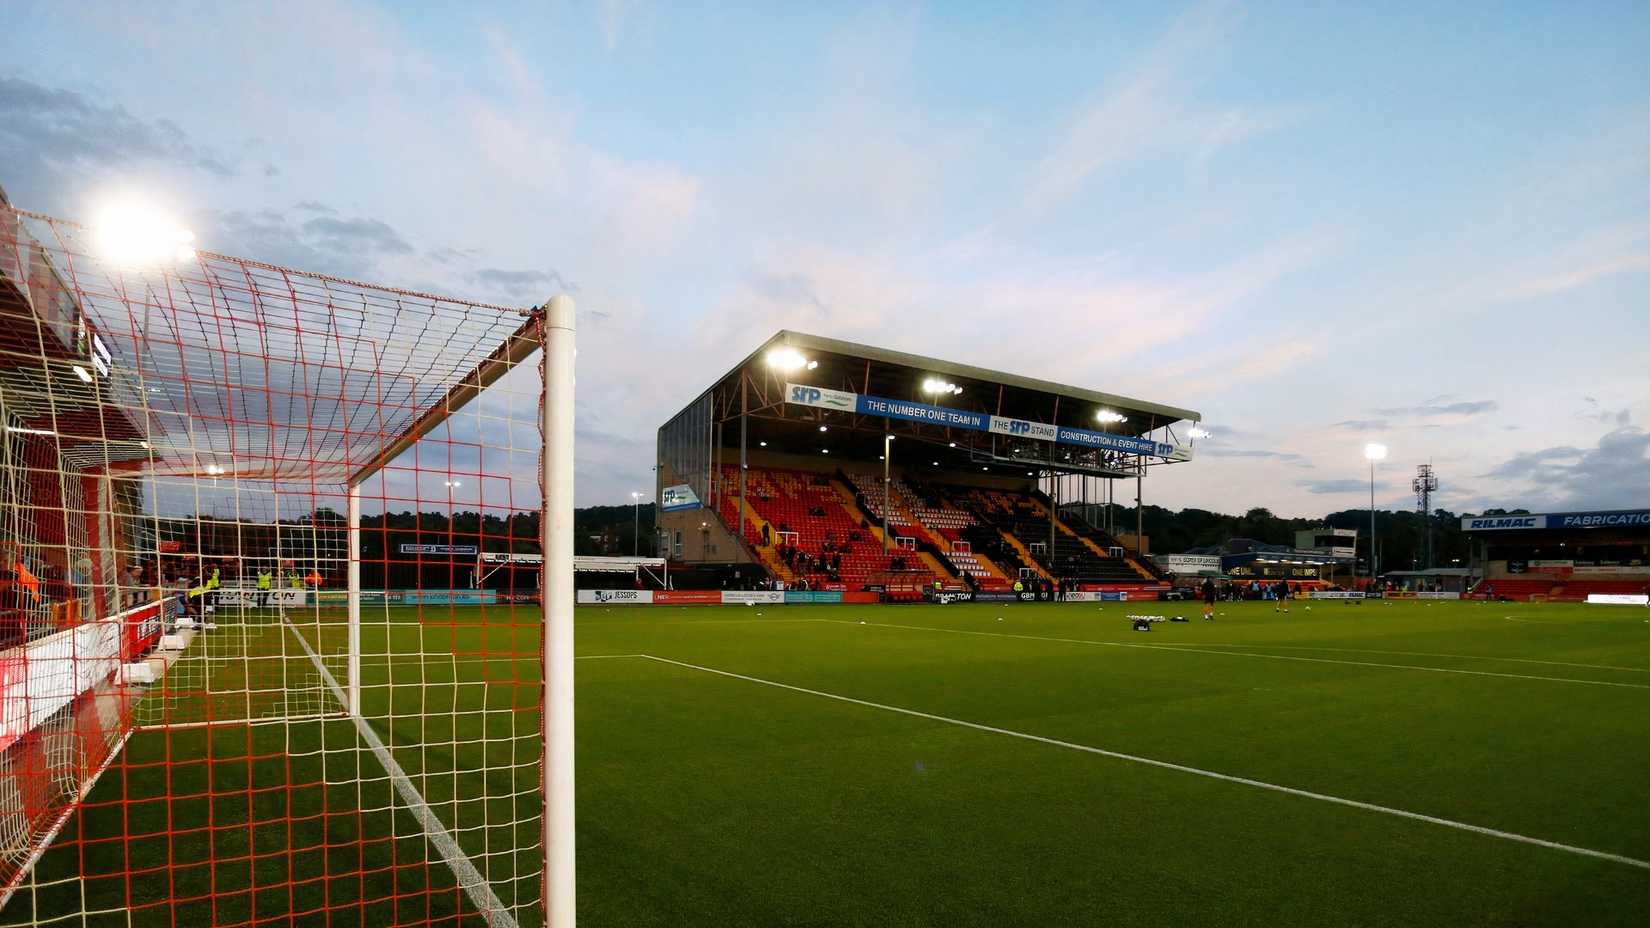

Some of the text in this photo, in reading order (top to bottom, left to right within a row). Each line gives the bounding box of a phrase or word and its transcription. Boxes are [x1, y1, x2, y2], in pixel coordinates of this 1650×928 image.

[868, 400, 981, 427] THE NUMBER ONE TEAM IN
[994, 420, 1008, 430] THE
[1031, 426, 1054, 437] STAND
[1060, 430, 1111, 446] CONSTRUCTION
[1118, 439, 1138, 450] EVENT
[1138, 441, 1153, 452] HIRE
[1470, 518, 1536, 529] RILMAC
[615, 591, 638, 599] JESSOPS
